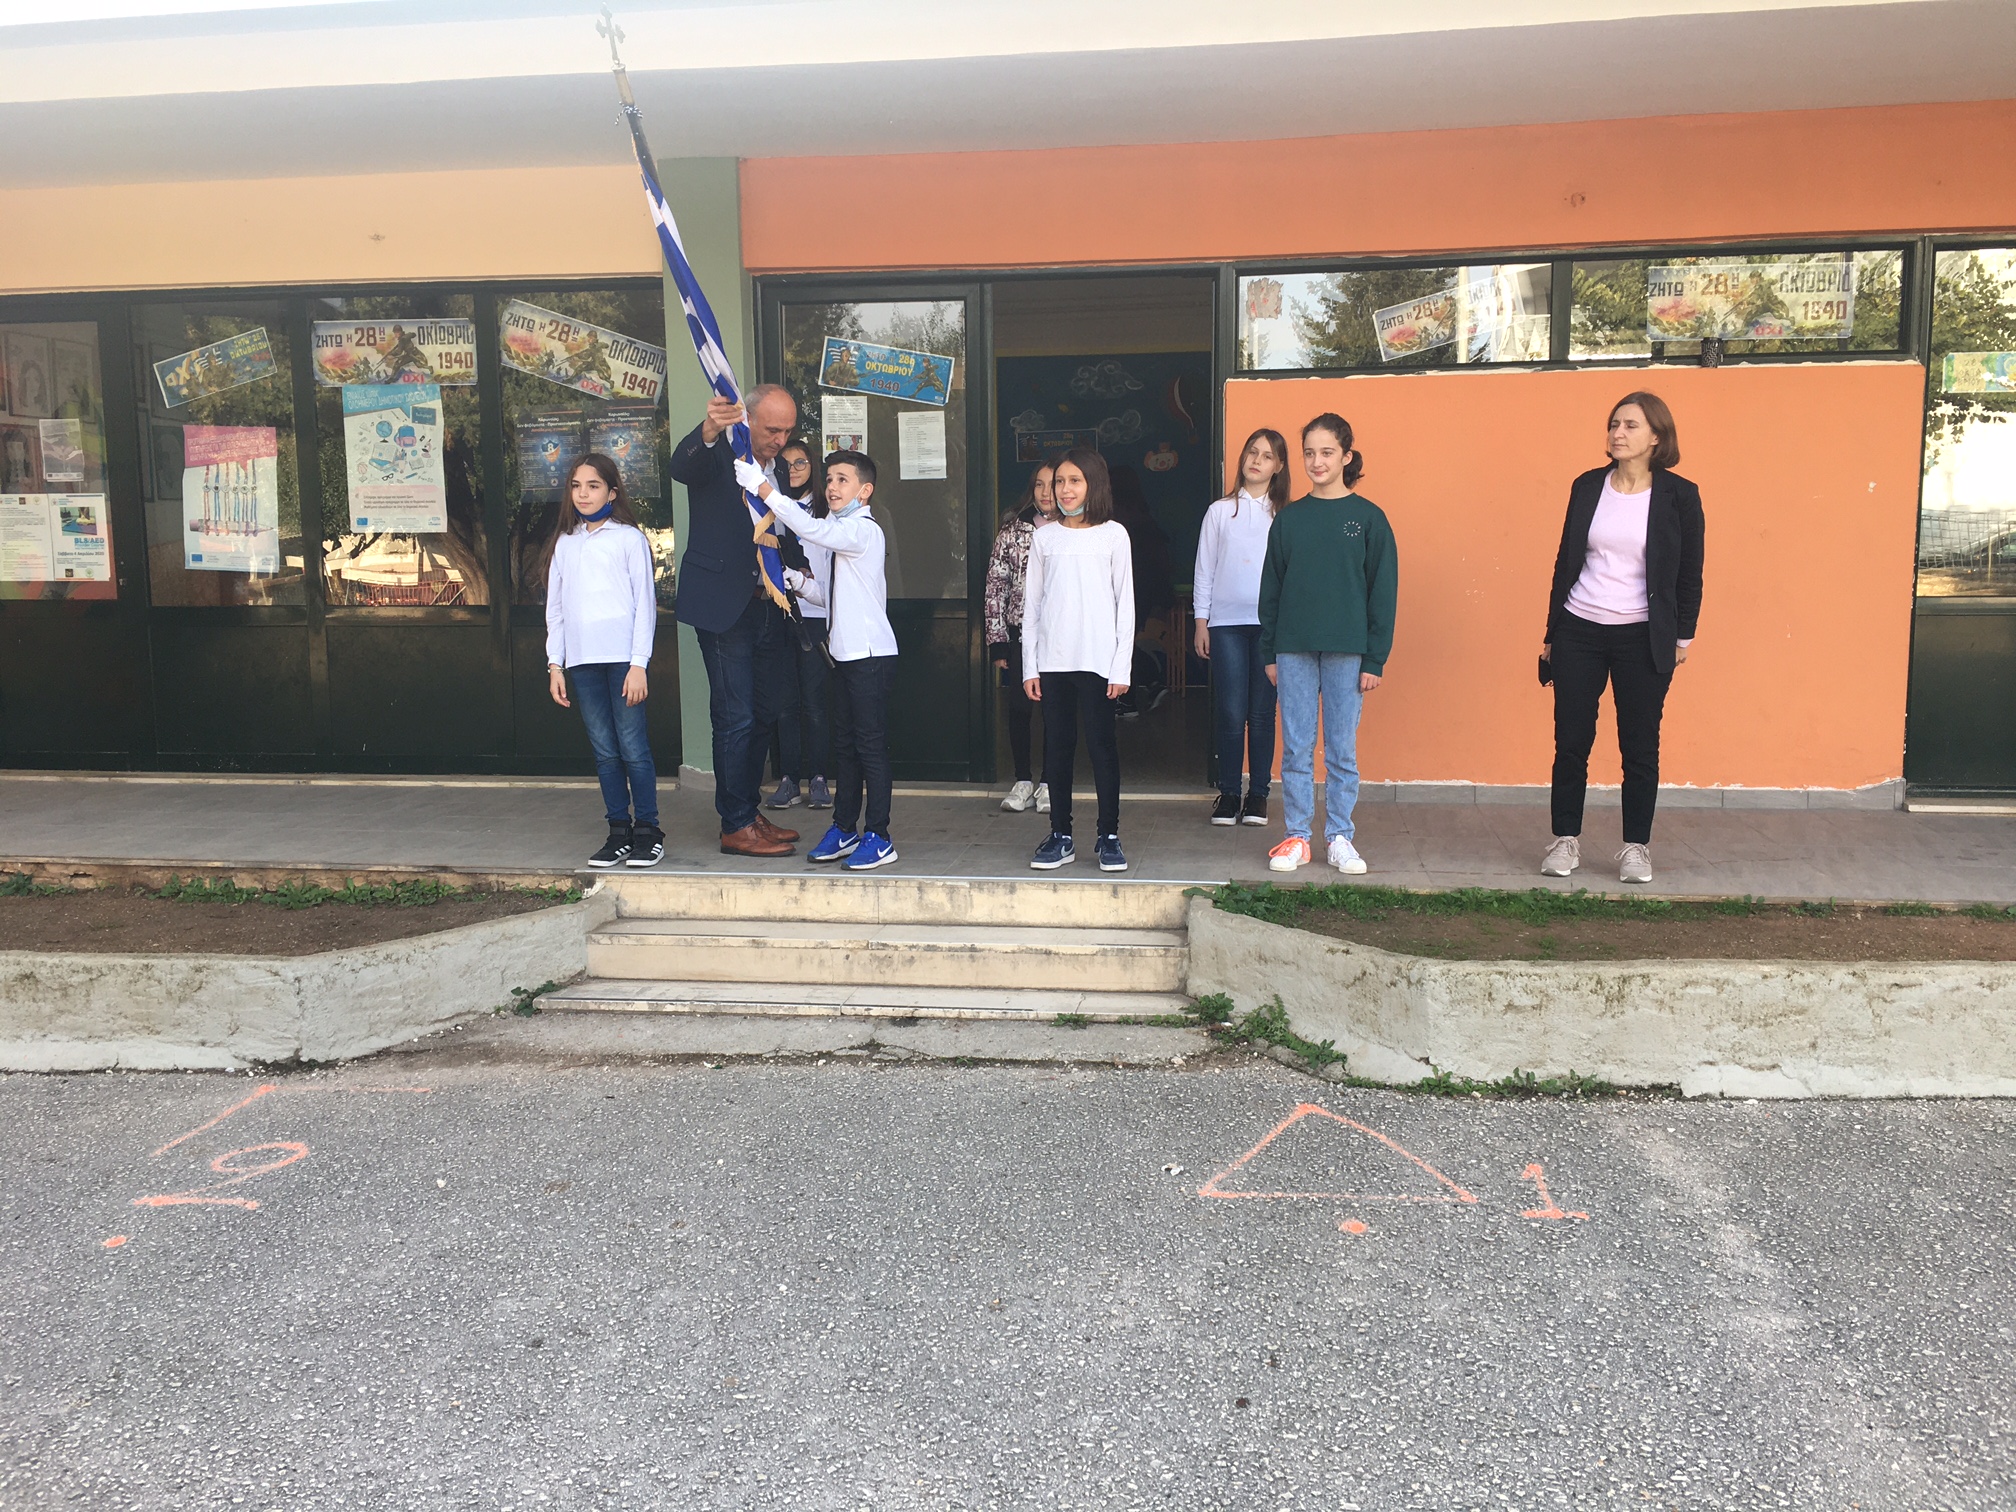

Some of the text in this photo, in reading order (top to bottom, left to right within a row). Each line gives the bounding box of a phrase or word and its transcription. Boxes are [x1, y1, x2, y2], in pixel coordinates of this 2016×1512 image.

[1648, 281, 1684, 297] ΖΗΤΩ
[505, 311, 536, 334] ΖΗΤΩ
[1380, 315, 1405, 331] ΖΗΤΩ
[315, 334, 343, 348] ΖΗΤΩ
[437, 351, 474, 369] 1940
[865, 360, 914, 377] ΟΚΤΩΒΡΙΟΥ
[402, 373, 425, 384] ΟΧΙ
[620, 370, 659, 399] 1940
[870, 378, 901, 392] 1940
[580, 379, 604, 395] ΟΧΙ
[1519, 1162, 1590, 1220] 1
